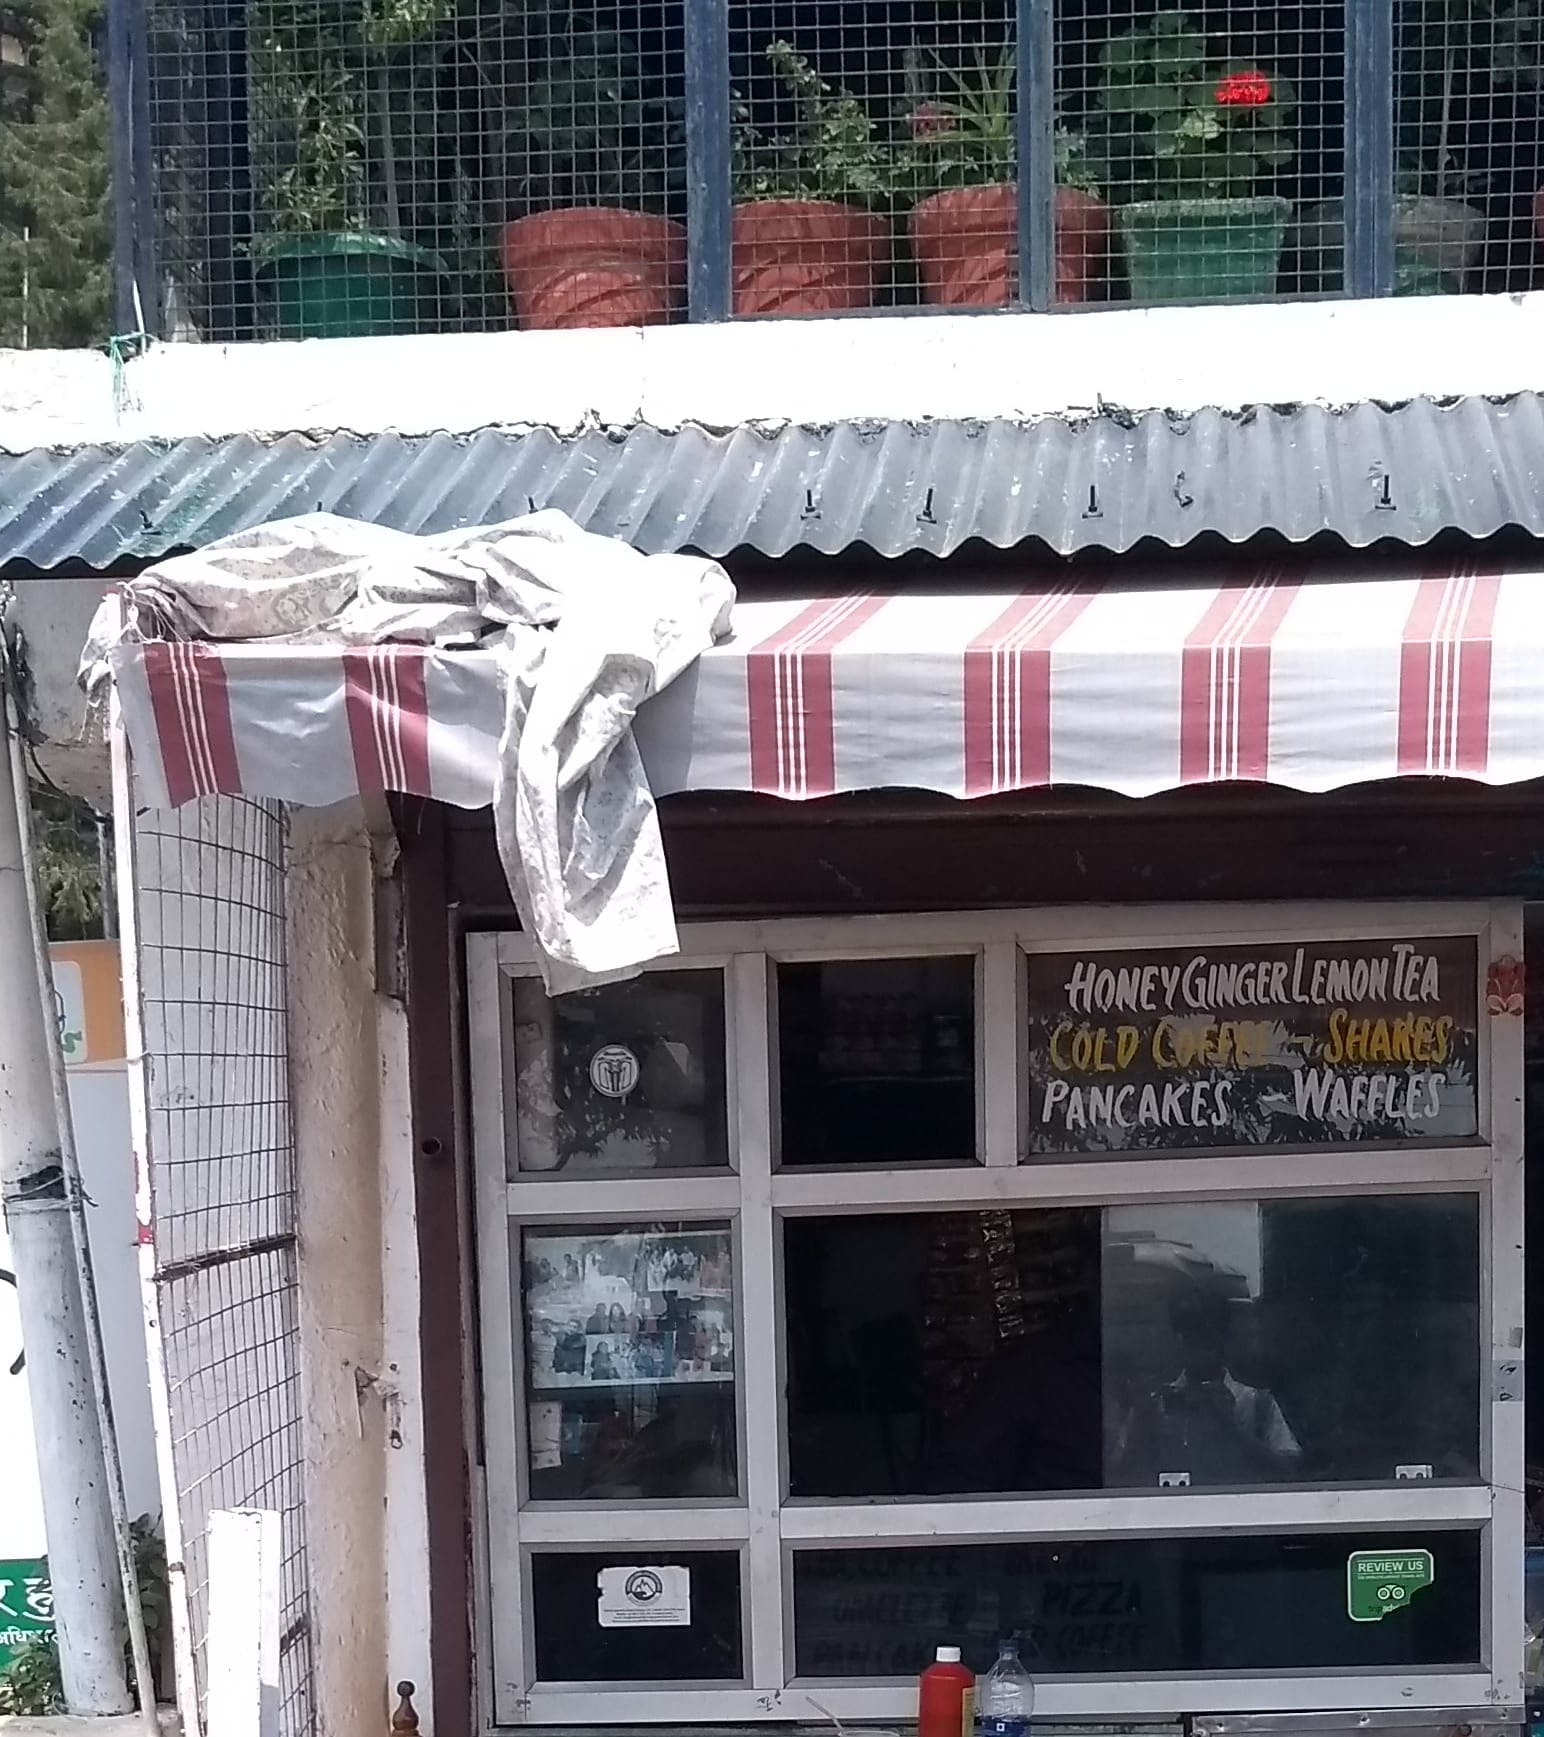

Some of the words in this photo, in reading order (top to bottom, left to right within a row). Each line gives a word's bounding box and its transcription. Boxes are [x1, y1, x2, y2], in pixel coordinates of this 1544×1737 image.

[1065, 961, 1181, 1013] HONEY
[1182, 955, 1289, 1008] GINGER
[1292, 948, 1390, 1004] LEMON
[1391, 943, 1441, 1002] TEA
[1051, 1021, 1140, 1072] COLD
[1323, 1007, 1453, 1064] SHAKES
[1042, 1080, 1232, 1130] PANCAKES
[1294, 1067, 1445, 1122] WAFFLES
[1358, 1562, 1403, 1572] REVIEW
[1408, 1561, 1423, 1570] US
